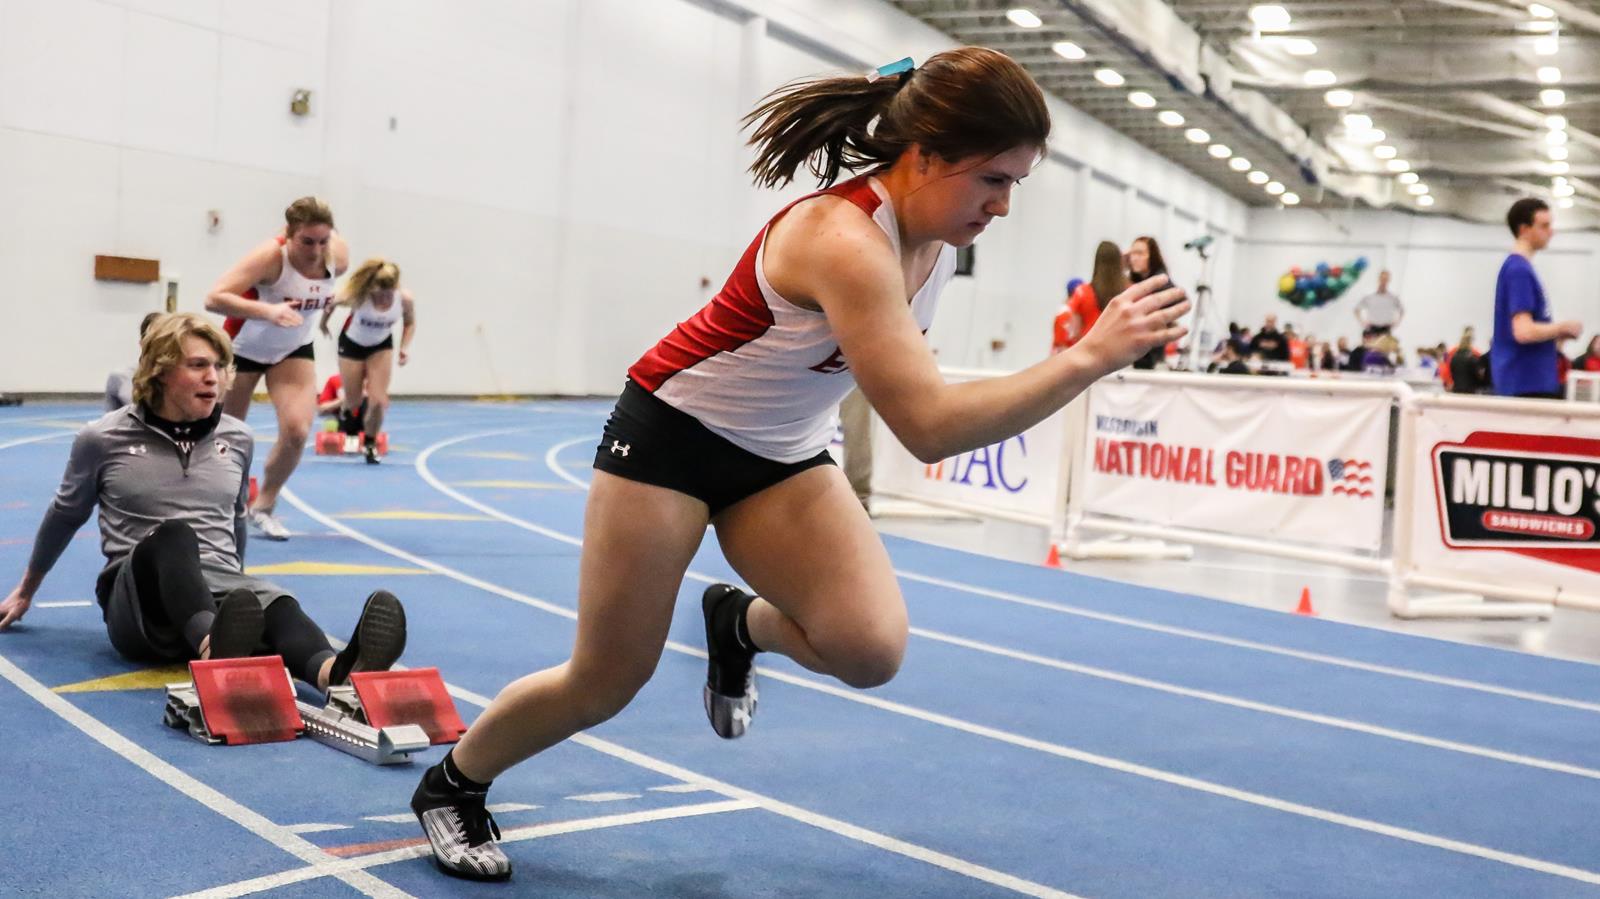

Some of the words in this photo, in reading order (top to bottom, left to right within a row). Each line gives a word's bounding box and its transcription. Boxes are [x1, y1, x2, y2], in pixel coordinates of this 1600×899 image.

[1094, 438, 1216, 485] NATIONAL
[1225, 450, 1324, 496] GUARD
[1491, 515, 1585, 535] SANDWICHES
